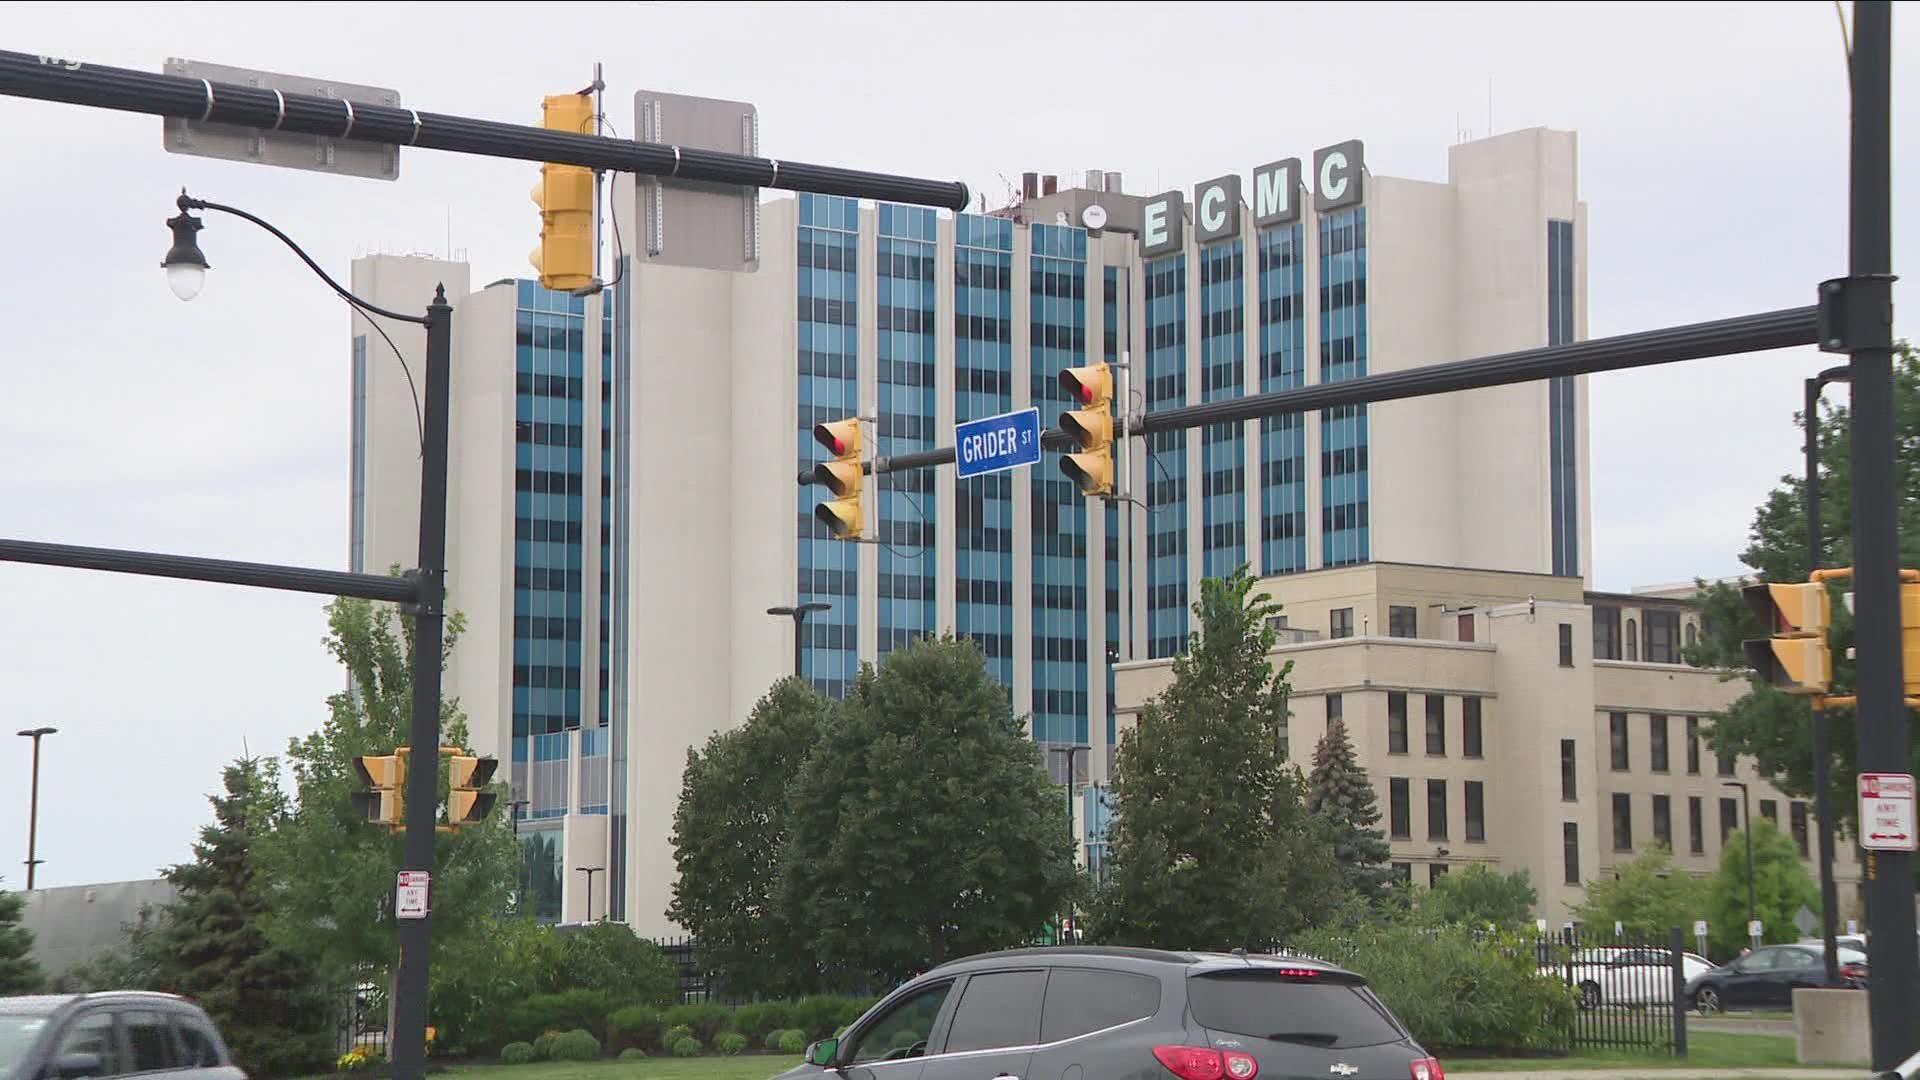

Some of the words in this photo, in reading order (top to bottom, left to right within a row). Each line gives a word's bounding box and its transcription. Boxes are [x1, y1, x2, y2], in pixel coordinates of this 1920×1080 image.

[1144, 151, 1349, 248] ECMC
[963, 427, 1018, 463] GRIDER
[1021, 429, 1032, 446] ST
[1877, 804, 1897, 813] ANY
